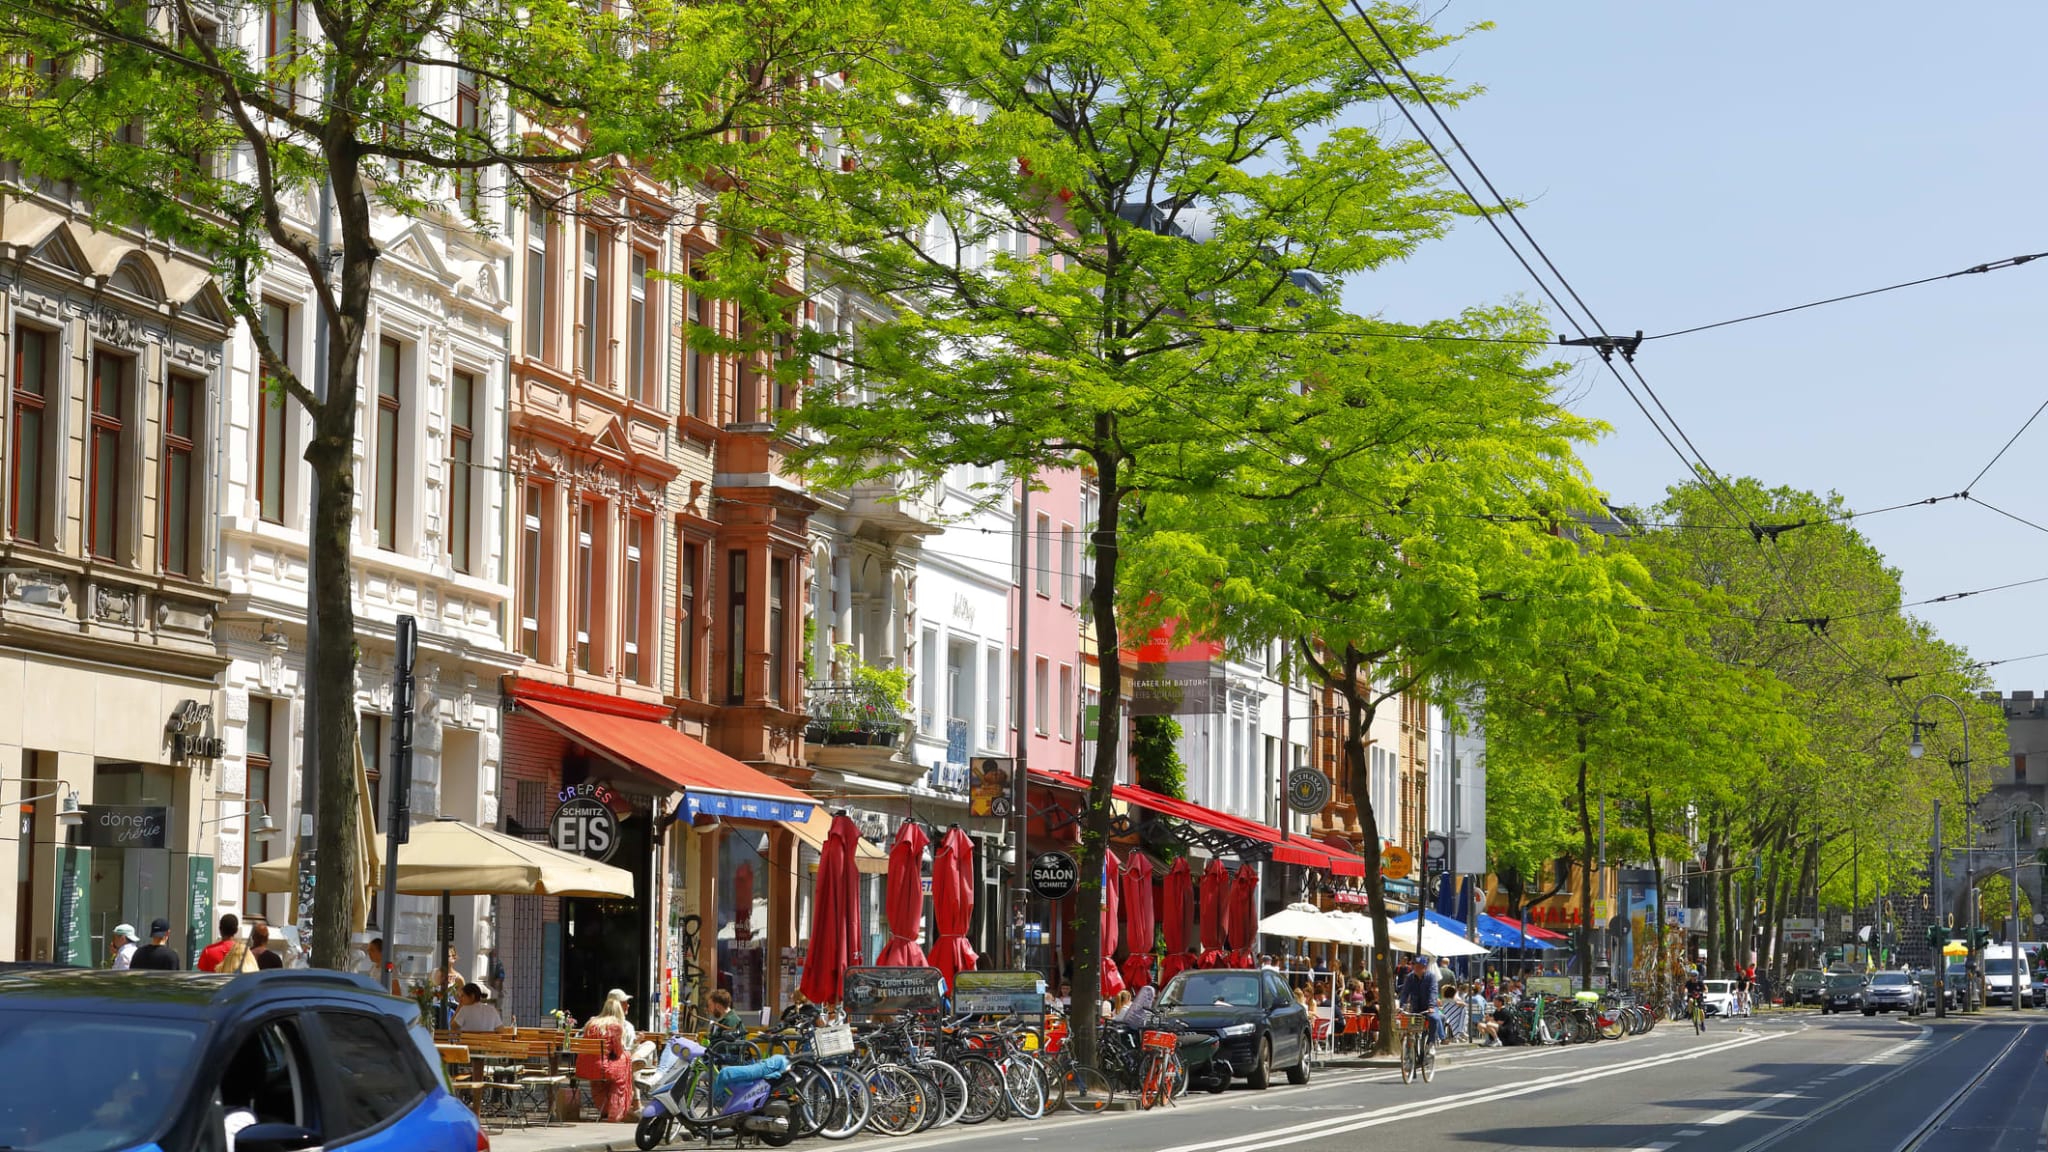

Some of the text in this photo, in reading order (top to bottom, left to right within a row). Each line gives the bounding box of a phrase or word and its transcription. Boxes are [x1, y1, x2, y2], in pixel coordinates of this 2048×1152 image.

[1128, 680, 1159, 688] THEATER
[558, 784, 612, 803] CREPES
[562, 808, 603, 816] SCHMITZ
[100, 811, 154, 827] döner
[558, 817, 610, 852] EIS
[1034, 869, 1074, 880] SALON
